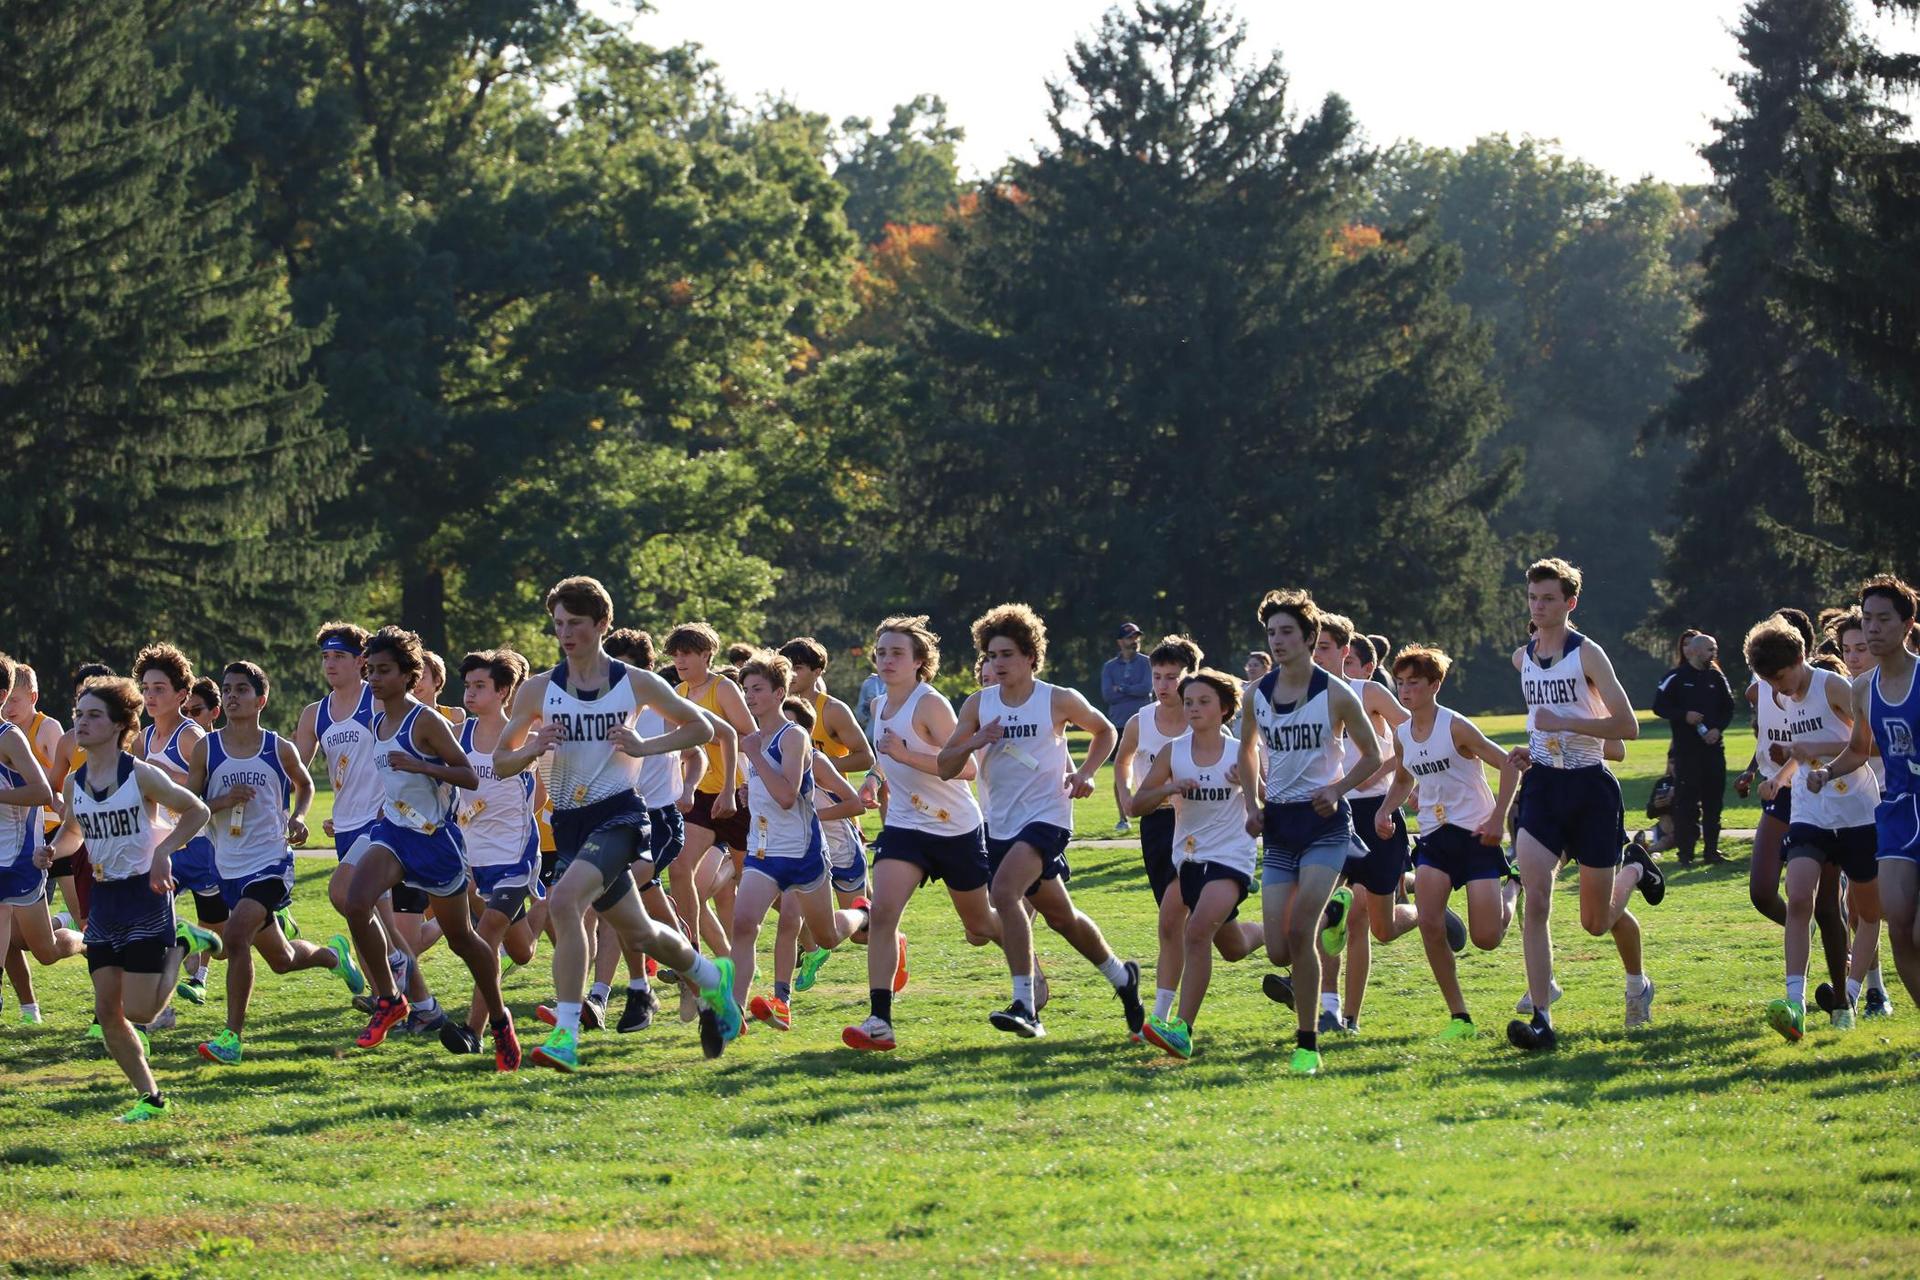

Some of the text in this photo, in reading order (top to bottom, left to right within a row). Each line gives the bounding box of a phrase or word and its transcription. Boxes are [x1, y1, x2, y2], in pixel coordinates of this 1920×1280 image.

[1003, 724, 1038, 739] ATORY
[1260, 724, 1323, 752] RATORY
[1768, 728, 1793, 742] ORAT
[327, 731, 360, 748] RAIDERS
[222, 772, 267, 787] RAIDERS
